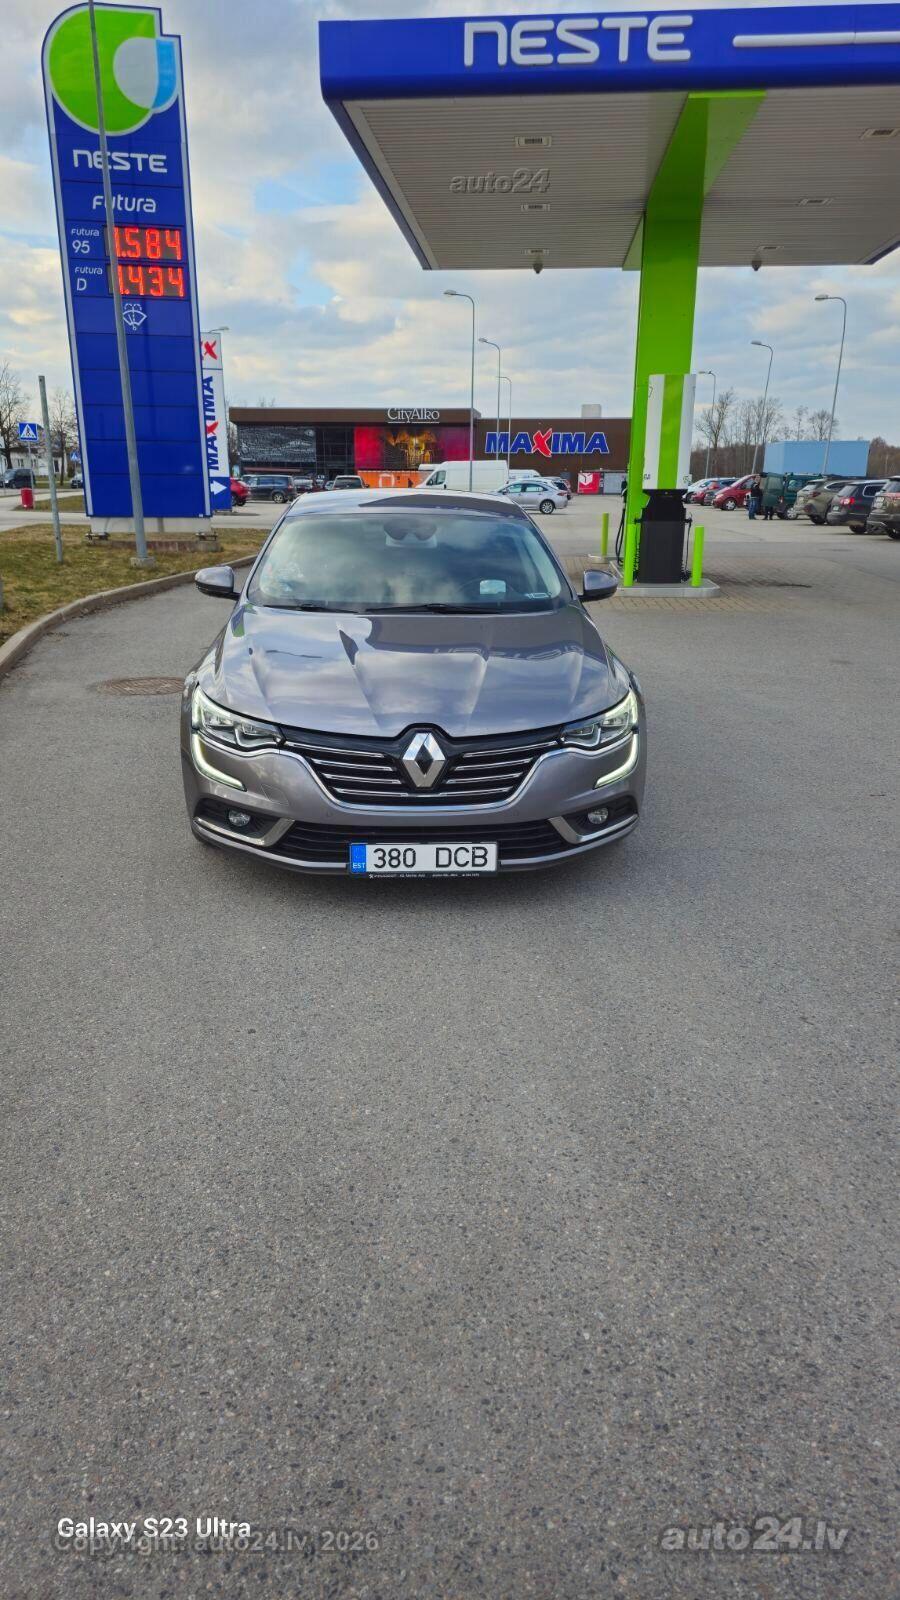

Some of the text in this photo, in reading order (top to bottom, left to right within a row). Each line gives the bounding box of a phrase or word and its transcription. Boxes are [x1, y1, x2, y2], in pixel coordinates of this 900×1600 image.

[464, 15, 693, 66] NESTE
[72, 149, 168, 173] NESTE
[72, 240, 90, 254] 95
[76, 278, 87, 291] D
[387, 408, 440, 423] CityAlko
[485, 428, 610, 457] MAXIMA
[373, 846, 489, 869] 380 DCB
